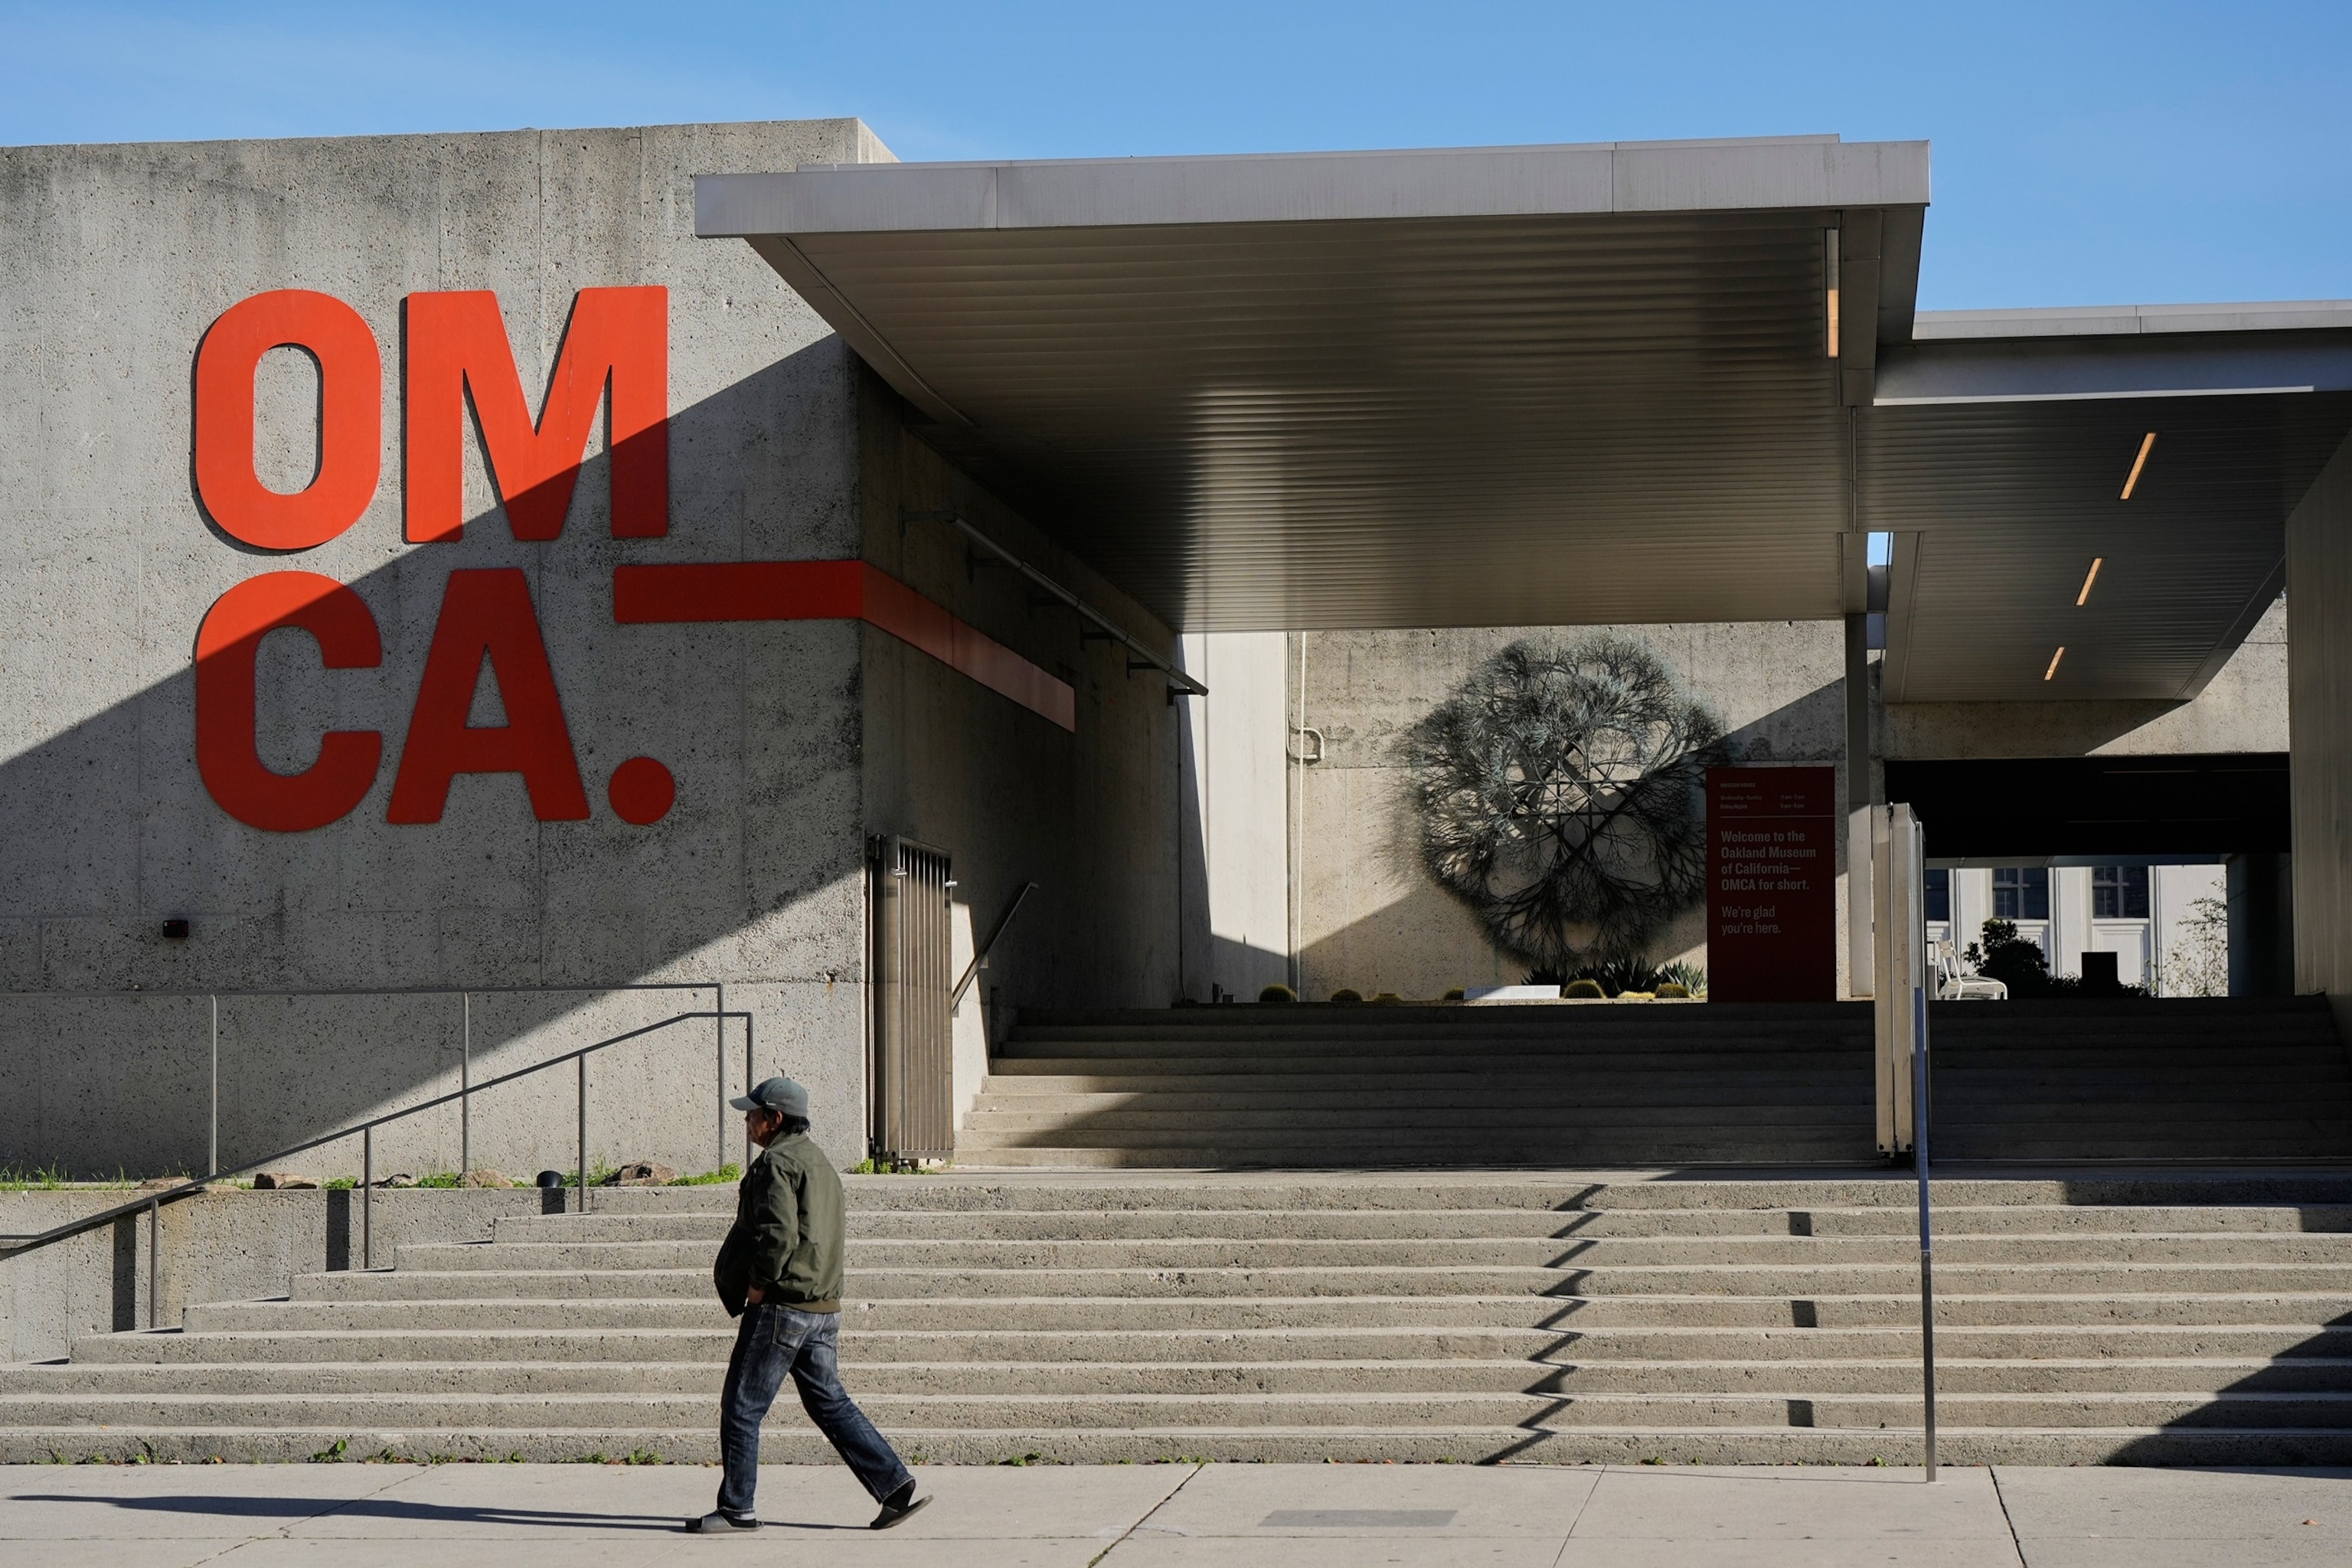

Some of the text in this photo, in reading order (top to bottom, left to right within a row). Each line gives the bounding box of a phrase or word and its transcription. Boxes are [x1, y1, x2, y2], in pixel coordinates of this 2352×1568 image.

[196, 286, 668, 550] OM
[1721, 831, 1805, 842] Welcome to the
[1721, 847, 1815, 858] Oakland Museum
[1721, 863, 1801, 874] of California—
[1722, 879, 1809, 890] OMCA for short.
[1753, 906, 1775, 920] glad
[1756, 922, 1781, 933] here.
